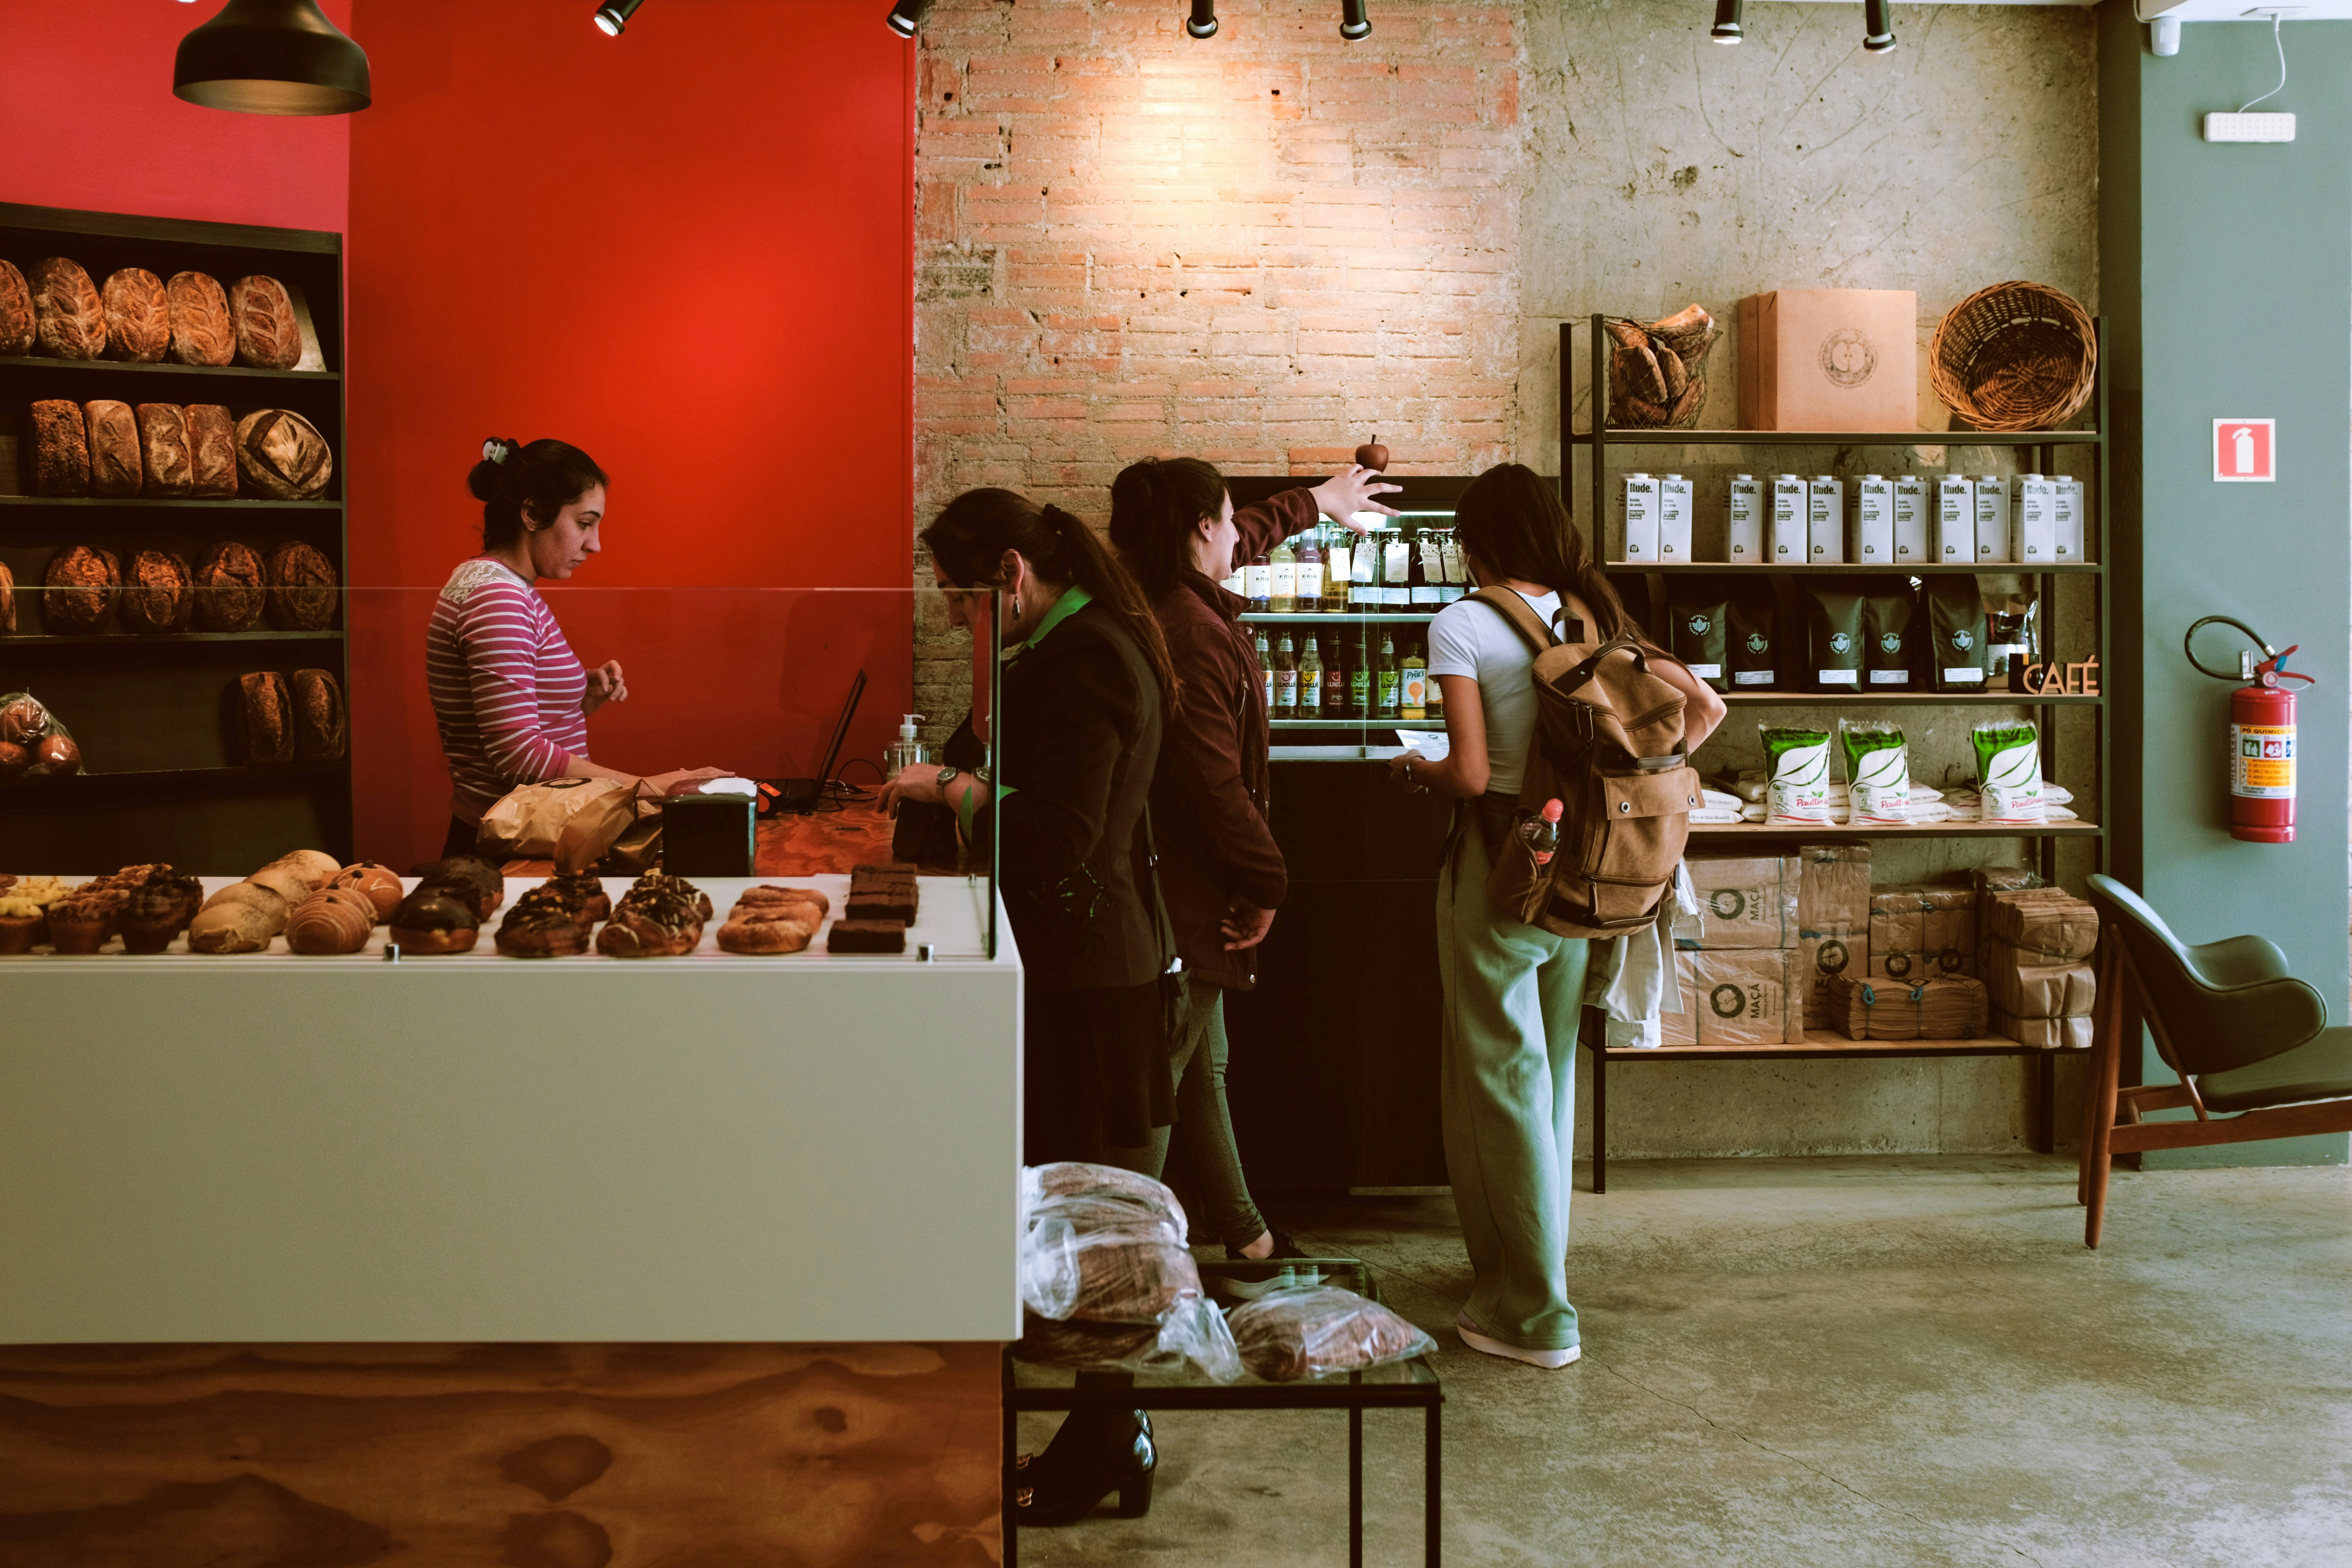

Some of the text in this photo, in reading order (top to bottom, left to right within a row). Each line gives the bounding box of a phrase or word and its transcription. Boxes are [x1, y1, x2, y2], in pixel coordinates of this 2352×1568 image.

[1630, 483, 1653, 493] Nude.
[1778, 484, 1800, 494] Nude.
[1813, 485, 1836, 495] Nude.
[1864, 485, 1886, 494] Nude.
[1898, 485, 1921, 495] Nude.
[1944, 485, 1967, 494] Nude.
[1980, 485, 2002, 495] Nude.
[2023, 655, 2100, 695] CAFÉ
[1747, 887, 1762, 920] MAÇÃ
[1748, 984, 1762, 1018] MAÇÃ
